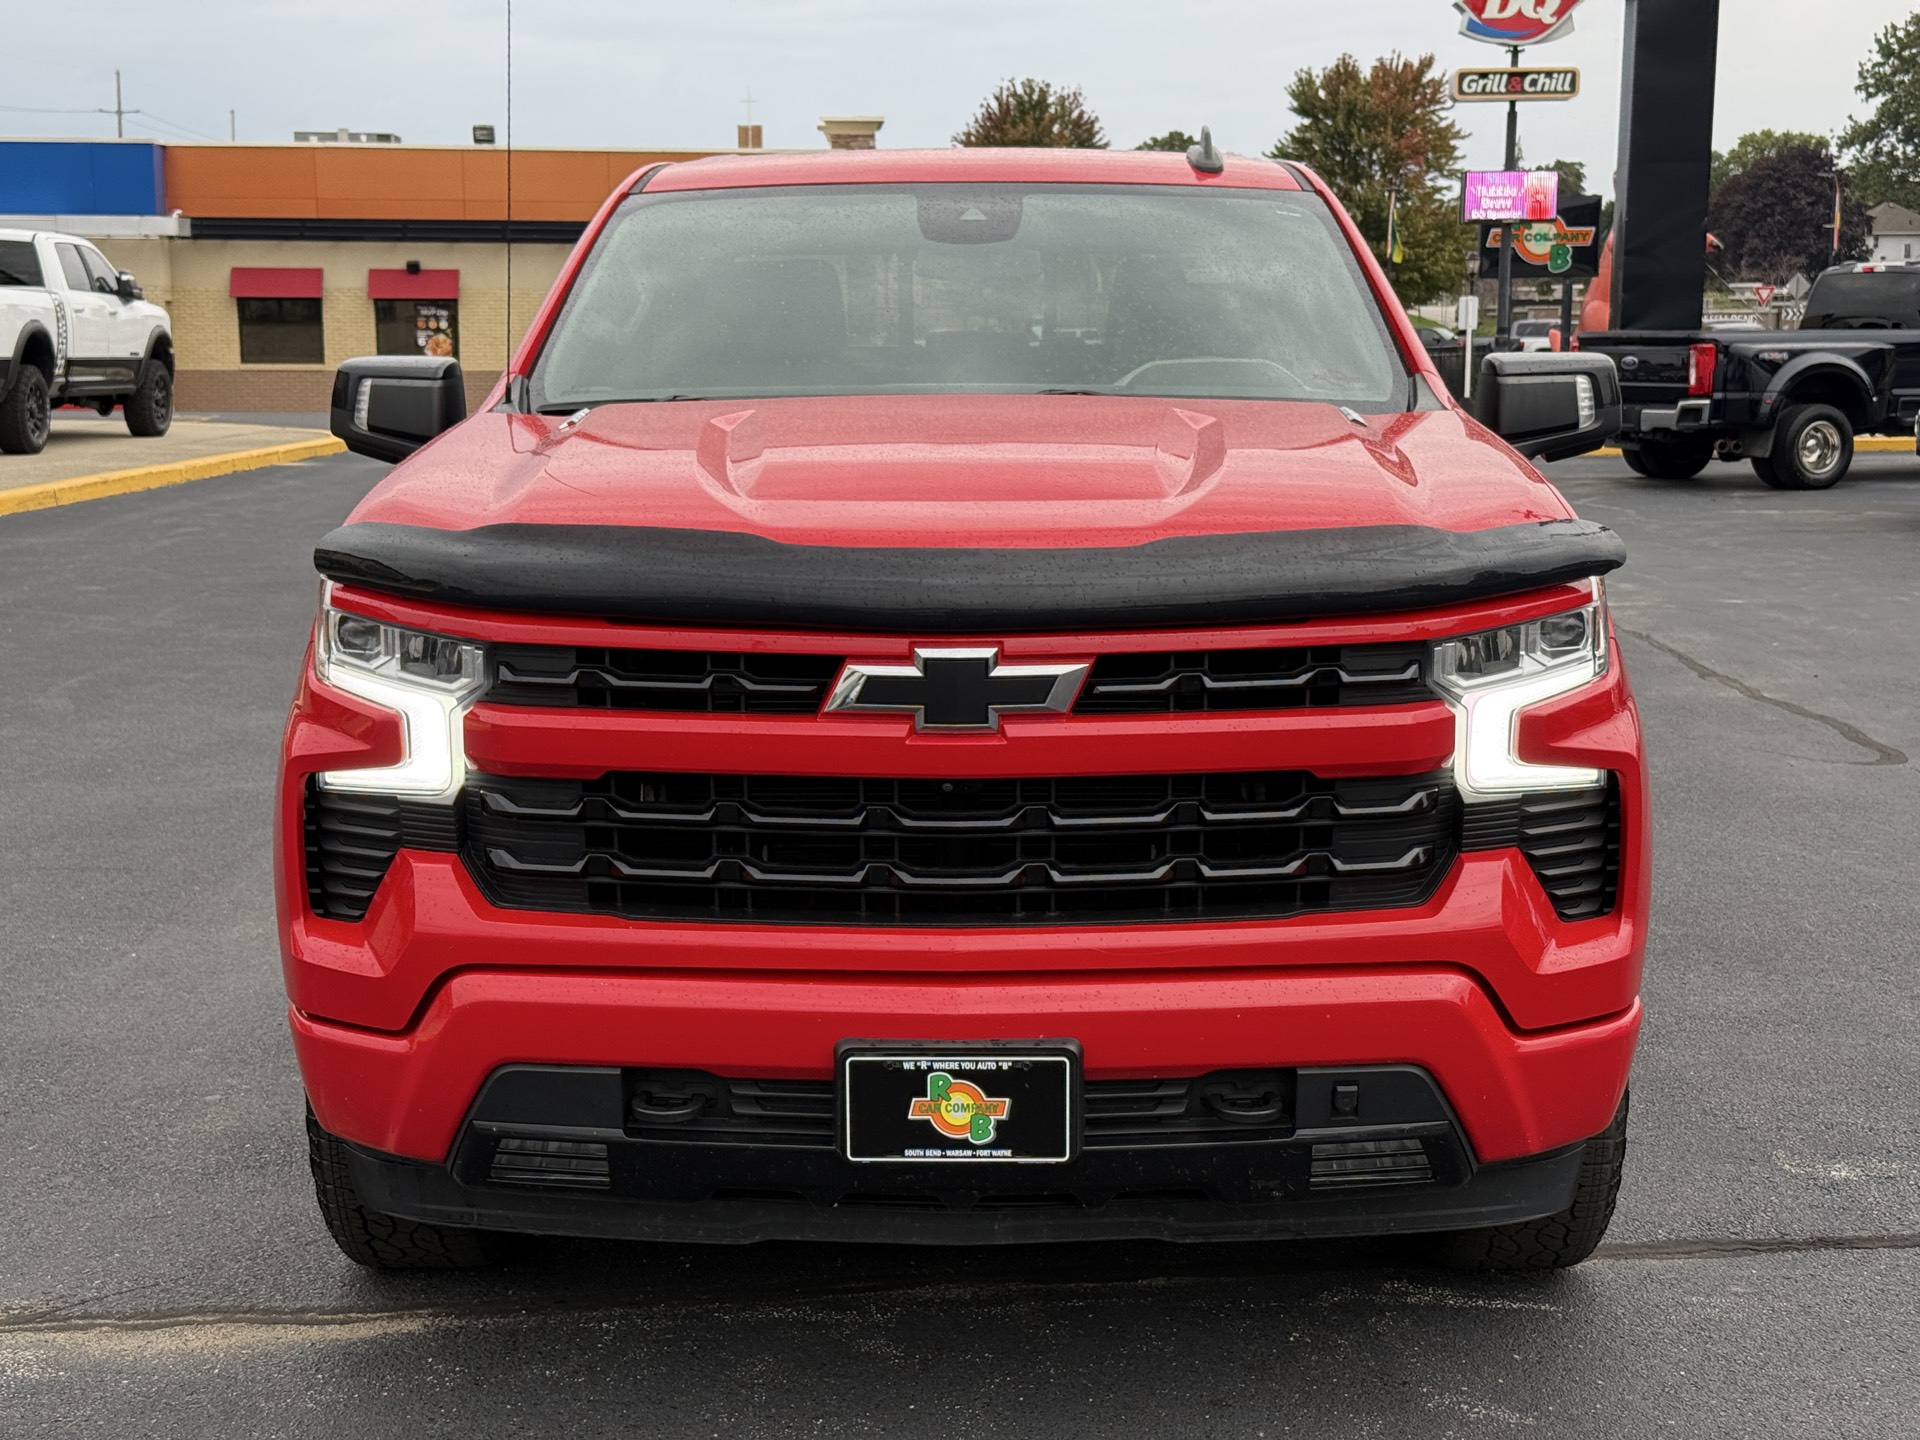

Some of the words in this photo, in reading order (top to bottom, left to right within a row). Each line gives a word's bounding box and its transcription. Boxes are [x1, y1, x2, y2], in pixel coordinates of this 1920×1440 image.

[1481, 0, 1561, 25] DQ
[1492, 233, 1520, 243] CR
[902, 1061, 915, 1070] WE
[916, 1060, 931, 1070] "R"
[932, 1061, 960, 1070] WHERE
[960, 1061, 976, 1070] YOU
[976, 1061, 997, 1070] AUTO
[998, 1061, 1012, 1070] "B"
[929, 1074, 952, 1102] R
[918, 1102, 941, 1113] CAR
[944, 1102, 999, 1113] COMPANY
[970, 1114, 992, 1141] B
[904, 1149, 924, 1157] SOUTH
[925, 1149, 941, 1157] BEND
[945, 1149, 972, 1157] WARSAW
[976, 1149, 991, 1157] FORT
[991, 1149, 1012, 1157] WAYNE
